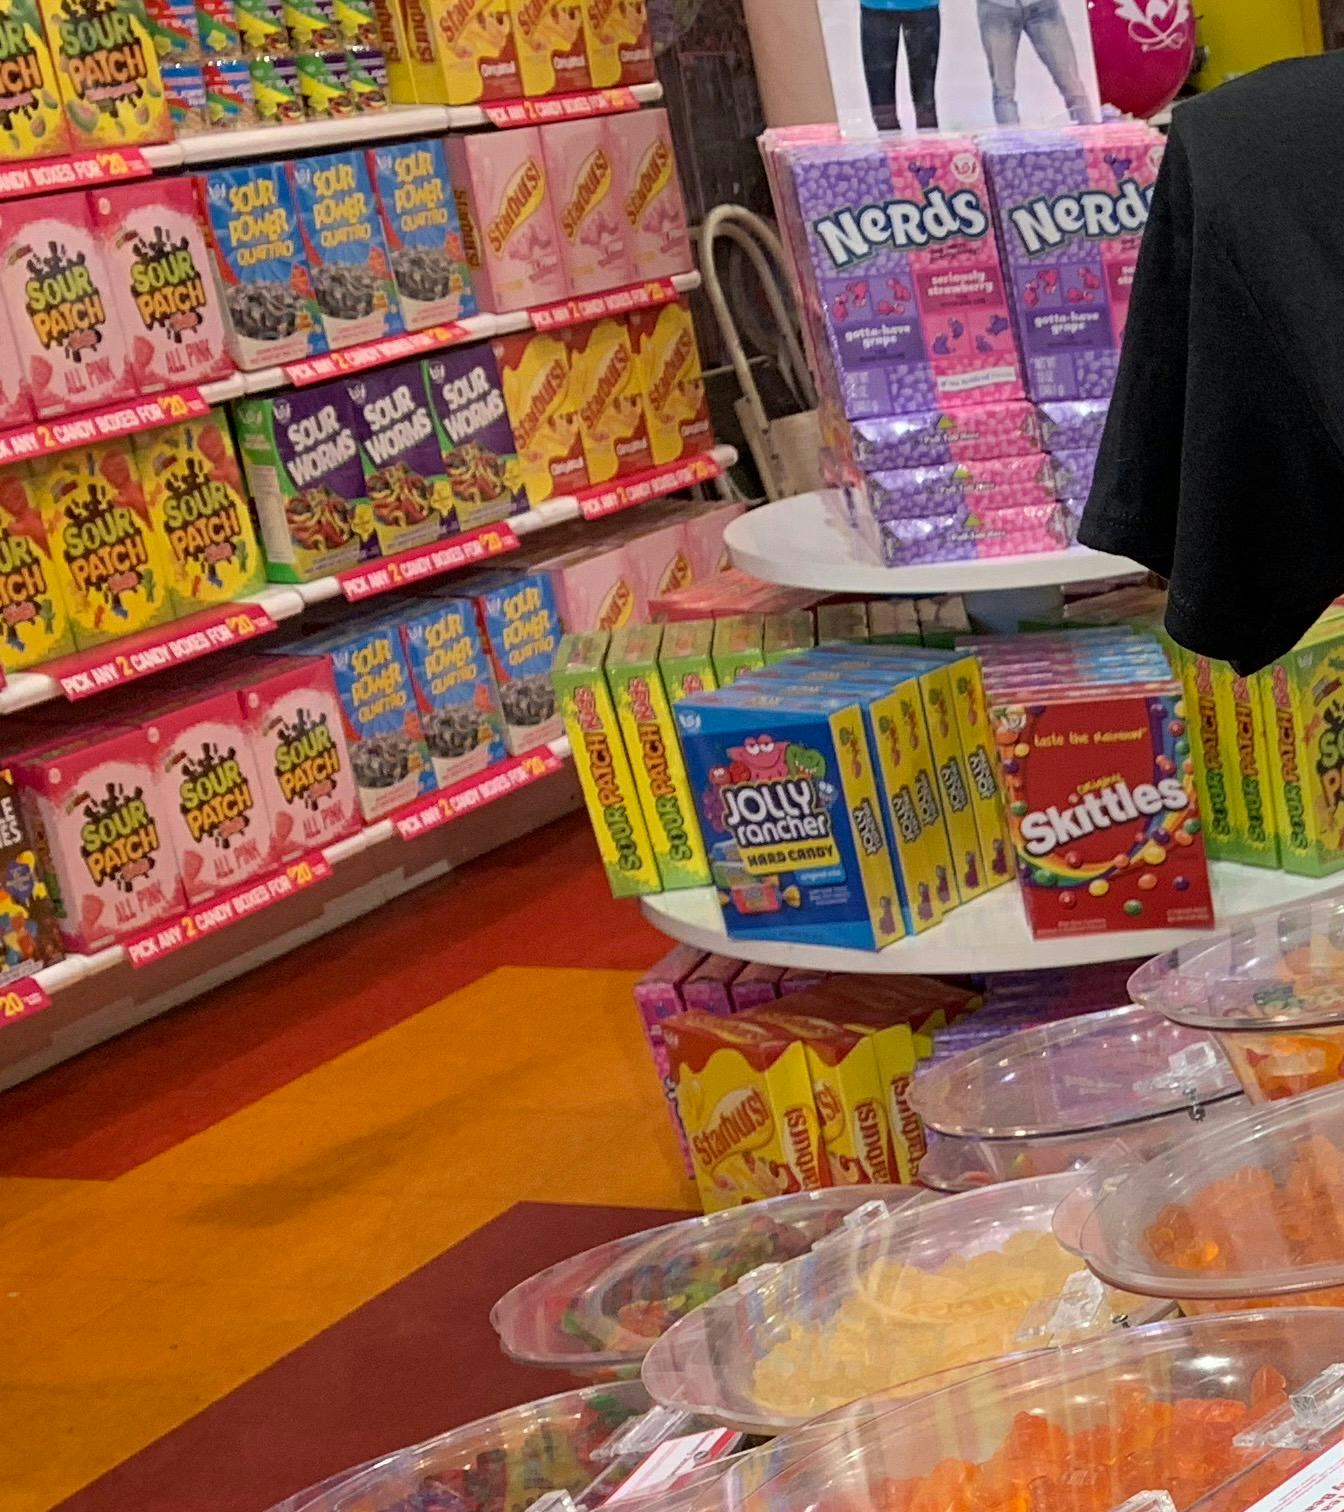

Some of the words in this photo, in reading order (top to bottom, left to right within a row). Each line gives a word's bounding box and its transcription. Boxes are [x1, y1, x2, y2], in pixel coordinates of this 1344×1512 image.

[59, 2, 134, 54] SOUR
[66, 44, 149, 98] PATCH
[394, 151, 433, 182] SOUR
[394, 178, 444, 212] POWER
[131, 252, 194, 289] SOUR
[927, 279, 994, 298] strawberry
[932, 270, 986, 287] seriously
[135, 282, 206, 327] PATCH
[844, 323, 911, 343] gotta-have
[862, 334, 898, 348] grape
[442, 366, 490, 404] SOUR
[287, 406, 341, 448] SOUR
[443, 389, 504, 442] WORMS
[288, 430, 357, 486] WORMS
[163, 481, 231, 521] SOUR
[169, 506, 240, 555] PATCH
[63, 671, 94, 695] PICK
[95, 663, 119, 684] ANY
[115, 656, 133, 676] 2
[131, 644, 169, 671] CANDY
[172, 631, 210, 658] BOXES
[209, 625, 234, 648] FOR
[1069, 730, 1089, 746] the
[180, 760, 242, 807] SOUR
[723, 779, 814, 826] JOLLY
[184, 788, 252, 840] PATCH
[735, 813, 830, 848] rancher
[1019, 777, 1190, 856] Skittles
[748, 851, 786, 867] HARD
[788, 845, 833, 864] CANDY
